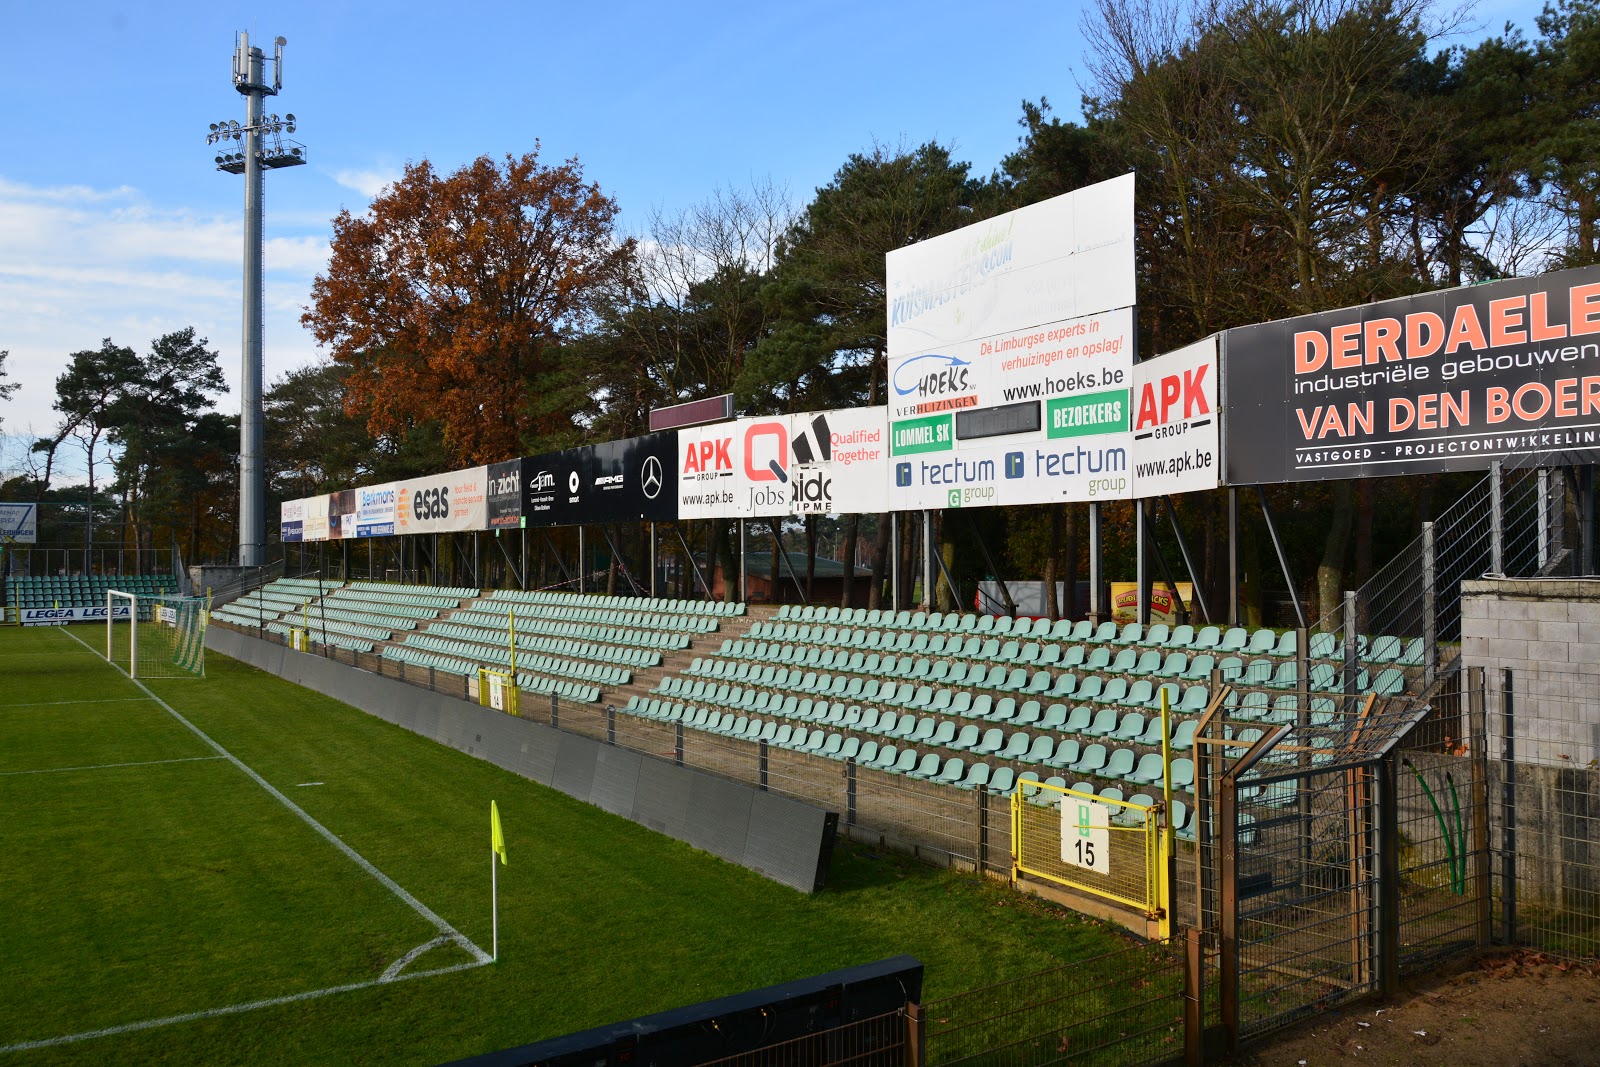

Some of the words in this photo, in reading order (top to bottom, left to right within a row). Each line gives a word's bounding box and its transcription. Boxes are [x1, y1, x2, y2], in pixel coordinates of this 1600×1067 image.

[980, 340, 992, 356] Dé
[994, 332, 1045, 353] Limburgse
[1047, 321, 1086, 345] experts
[1088, 319, 1100, 332] in
[1294, 282, 1600, 375] DERDAELE
[1001, 349, 1063, 372] verhuizingen
[1066, 346, 1079, 358] en
[1082, 335, 1124, 356] opslag!
[919, 366, 968, 397] HOEKS
[1294, 363, 1430, 394] industriële
[1441, 343, 1599, 380] gebouwen
[1003, 367, 1124, 402] www.hoeks.be
[1136, 364, 1210, 430] APK
[896, 396, 978, 417] VERHUIZINGEN
[1053, 401, 1122, 429] BEZOEKERS
[1296, 400, 1374, 440] VAN
[1388, 390, 1470, 433] DEN
[1486, 375, 1600, 424] BOER
[830, 428, 880, 445] Qualified
[895, 426, 934, 448] LOMMEL
[936, 424, 950, 442] SK
[1155, 422, 1188, 440] GROUP
[683, 437, 733, 474] APK
[832, 449, 881, 465] Together
[1036, 445, 1126, 477] tectum
[1295, 448, 1372, 463] VASTGOED
[1395, 431, 1600, 456] PROJECTONTWIKKELIN
[696, 472, 718, 481] GROUP
[921, 457, 995, 486] tectum
[1136, 449, 1212, 478] www.apk.be
[488, 470, 520, 496] in-zicht
[602, 475, 623, 484] AMG
[964, 485, 995, 502] group
[1088, 477, 1126, 495] group
[413, 486, 449, 521] esas
[682, 490, 734, 506] www.apk.be
[747, 486, 785, 511] Jobs
[26, 609, 75, 619] LEGEA
[1075, 839, 1095, 867] 15
